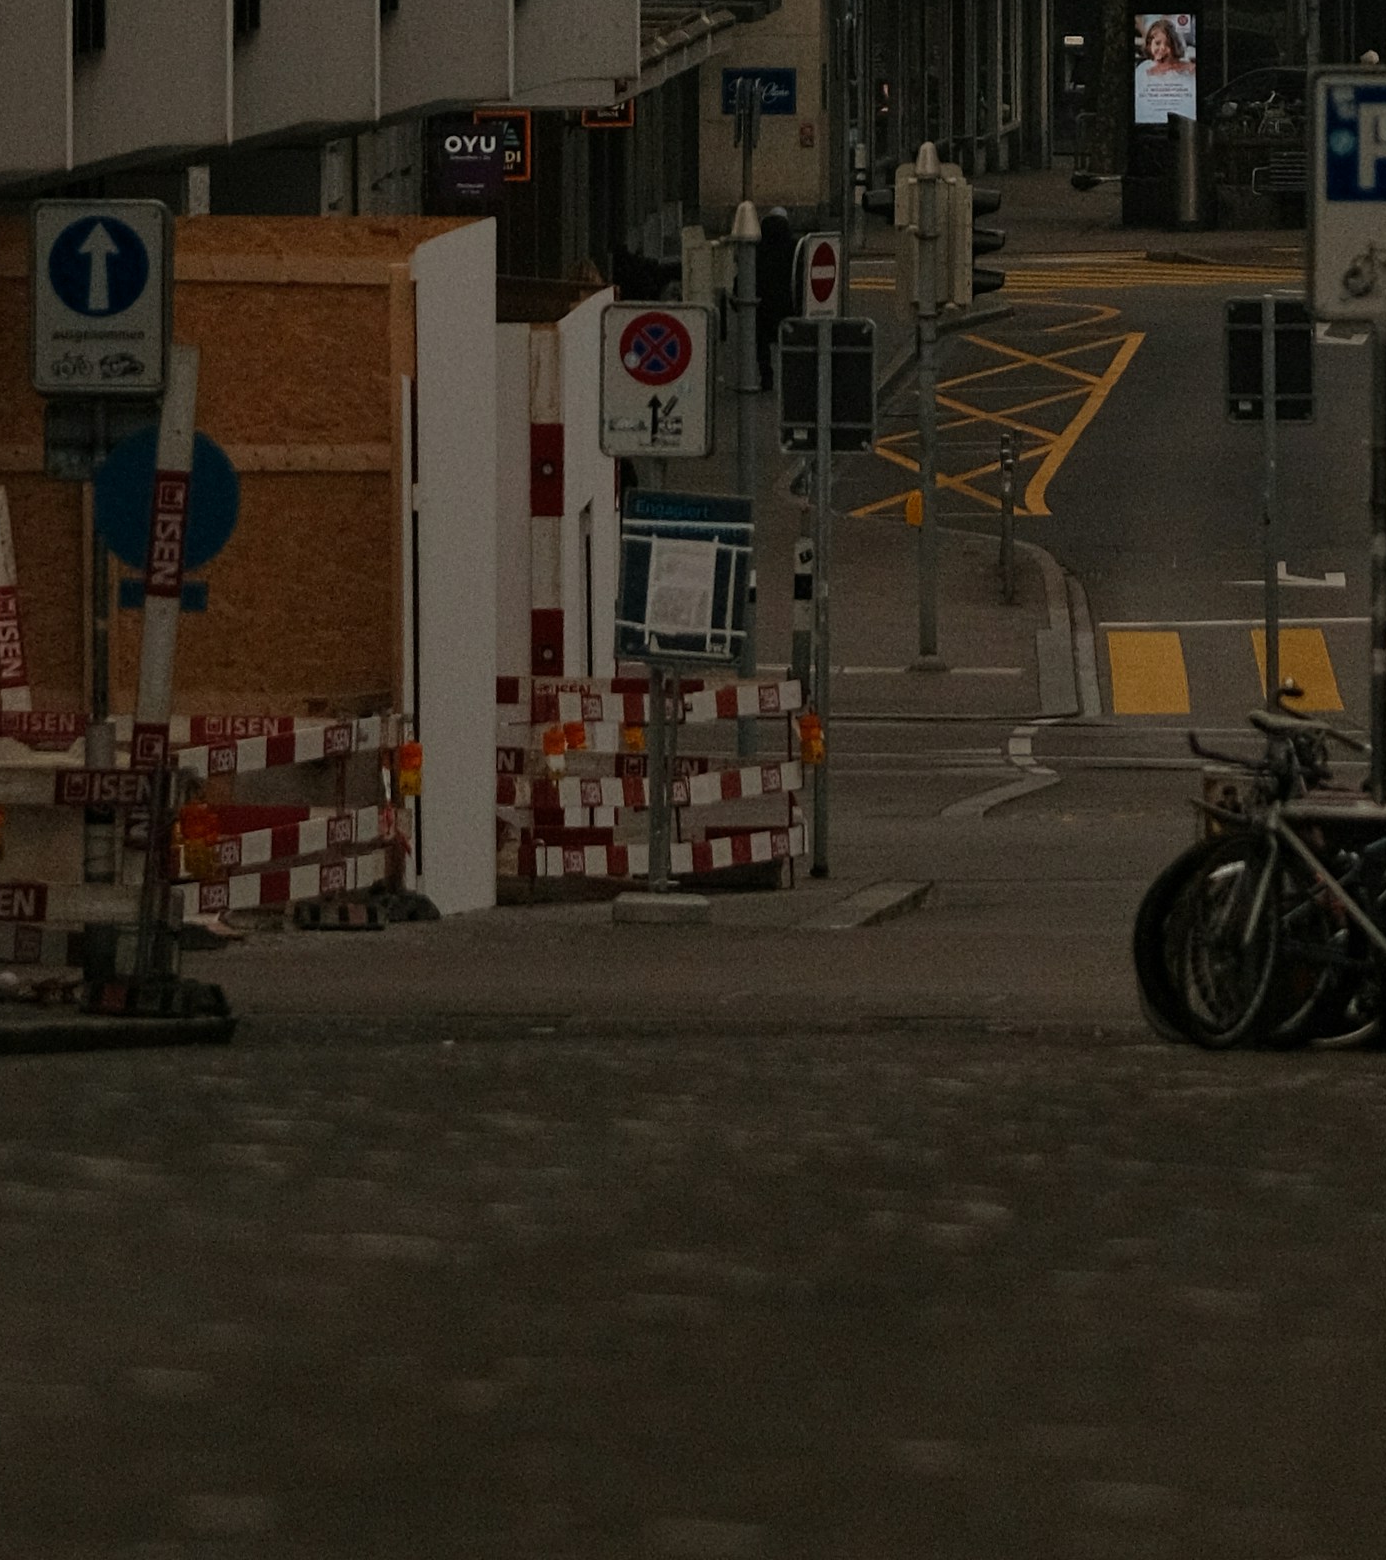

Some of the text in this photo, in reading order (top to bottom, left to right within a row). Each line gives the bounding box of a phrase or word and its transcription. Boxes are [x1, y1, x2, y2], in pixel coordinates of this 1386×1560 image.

[444, 135, 497, 154] OYU
[52, 329, 146, 343] ausgenommen
[150, 513, 183, 586] ISEN
[21, 714, 76, 733] ISEN
[225, 716, 280, 736] ISEN
[92, 773, 153, 802] ISEN
